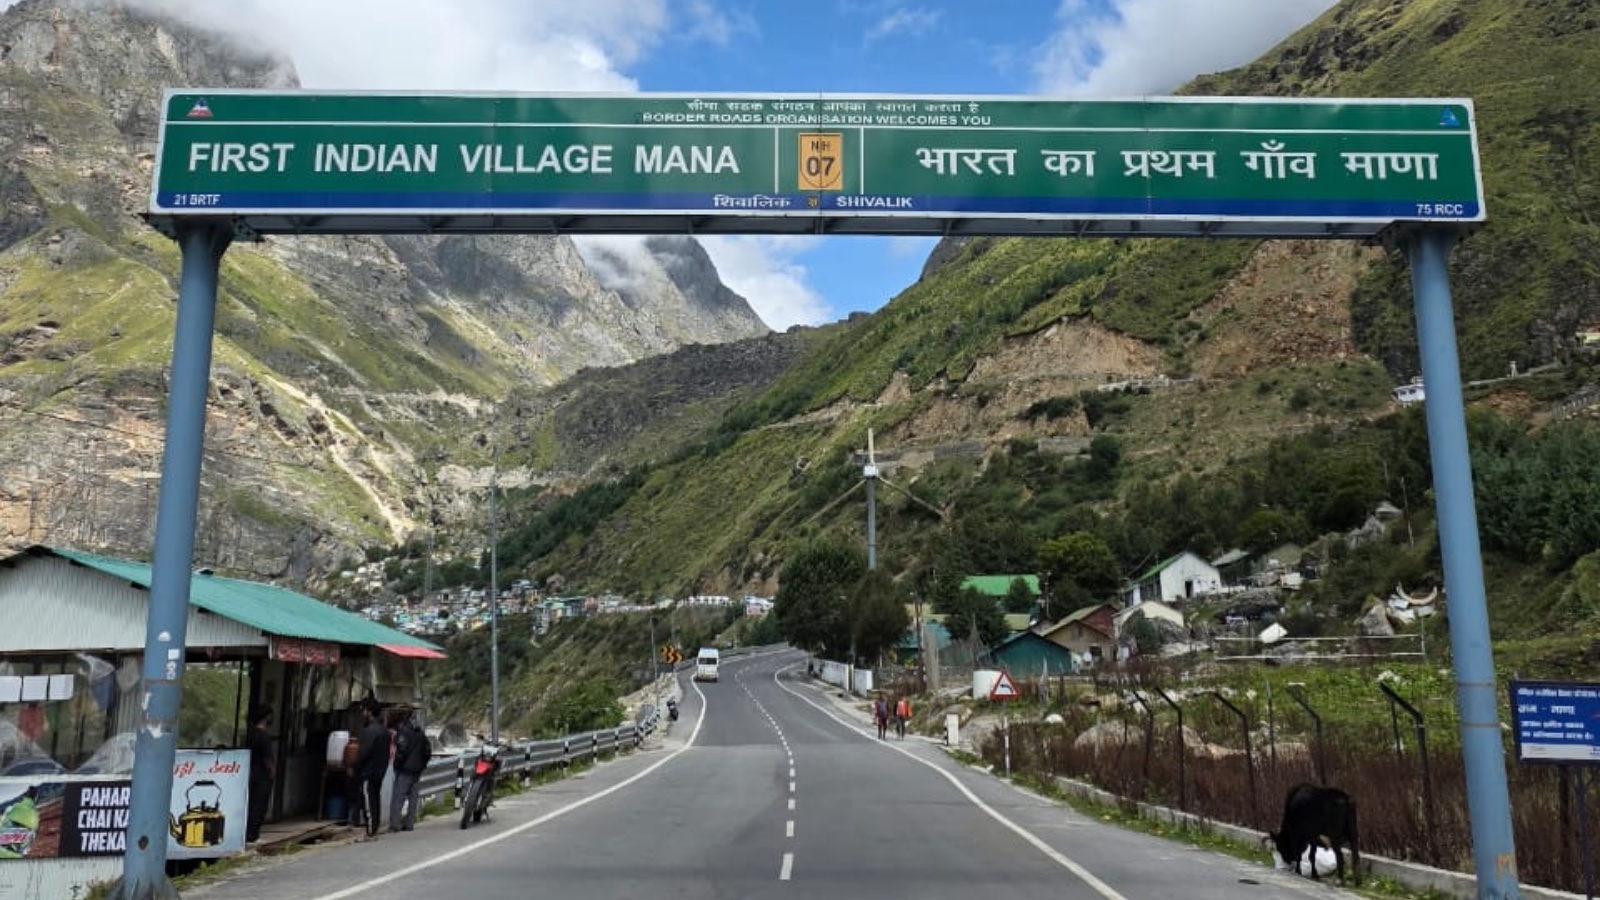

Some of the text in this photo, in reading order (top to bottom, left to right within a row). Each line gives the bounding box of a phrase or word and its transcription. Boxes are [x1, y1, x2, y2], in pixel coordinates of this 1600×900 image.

[686, 99, 718, 111] सीमा
[771, 99, 815, 112] संगठन
[822, 102, 866, 112] आपका
[876, 102, 916, 112] स्वागत
[925, 103, 961, 112] करता
[968, 100, 980, 114] है
[642, 112, 991, 126] BORDER ROADS ORGANISATION WELCOMES YOU
[811, 140, 831, 152] NH
[188, 142, 741, 175] FIRST INDIAN VILLAGE MANA
[807, 156, 835, 176] 07
[915, 139, 1439, 180] भारत का प्रथम गाँव माणा
[173, 194, 221, 206] 21 BRTF
[713, 193, 791, 208] शिवालिक
[836, 195, 913, 208] SHIVALIK
[1416, 203, 1464, 216] 75 RCC
[81, 786, 131, 807] PAHAR
[78, 809, 112, 829] CHAI
[81, 831, 127, 852] THEKA
